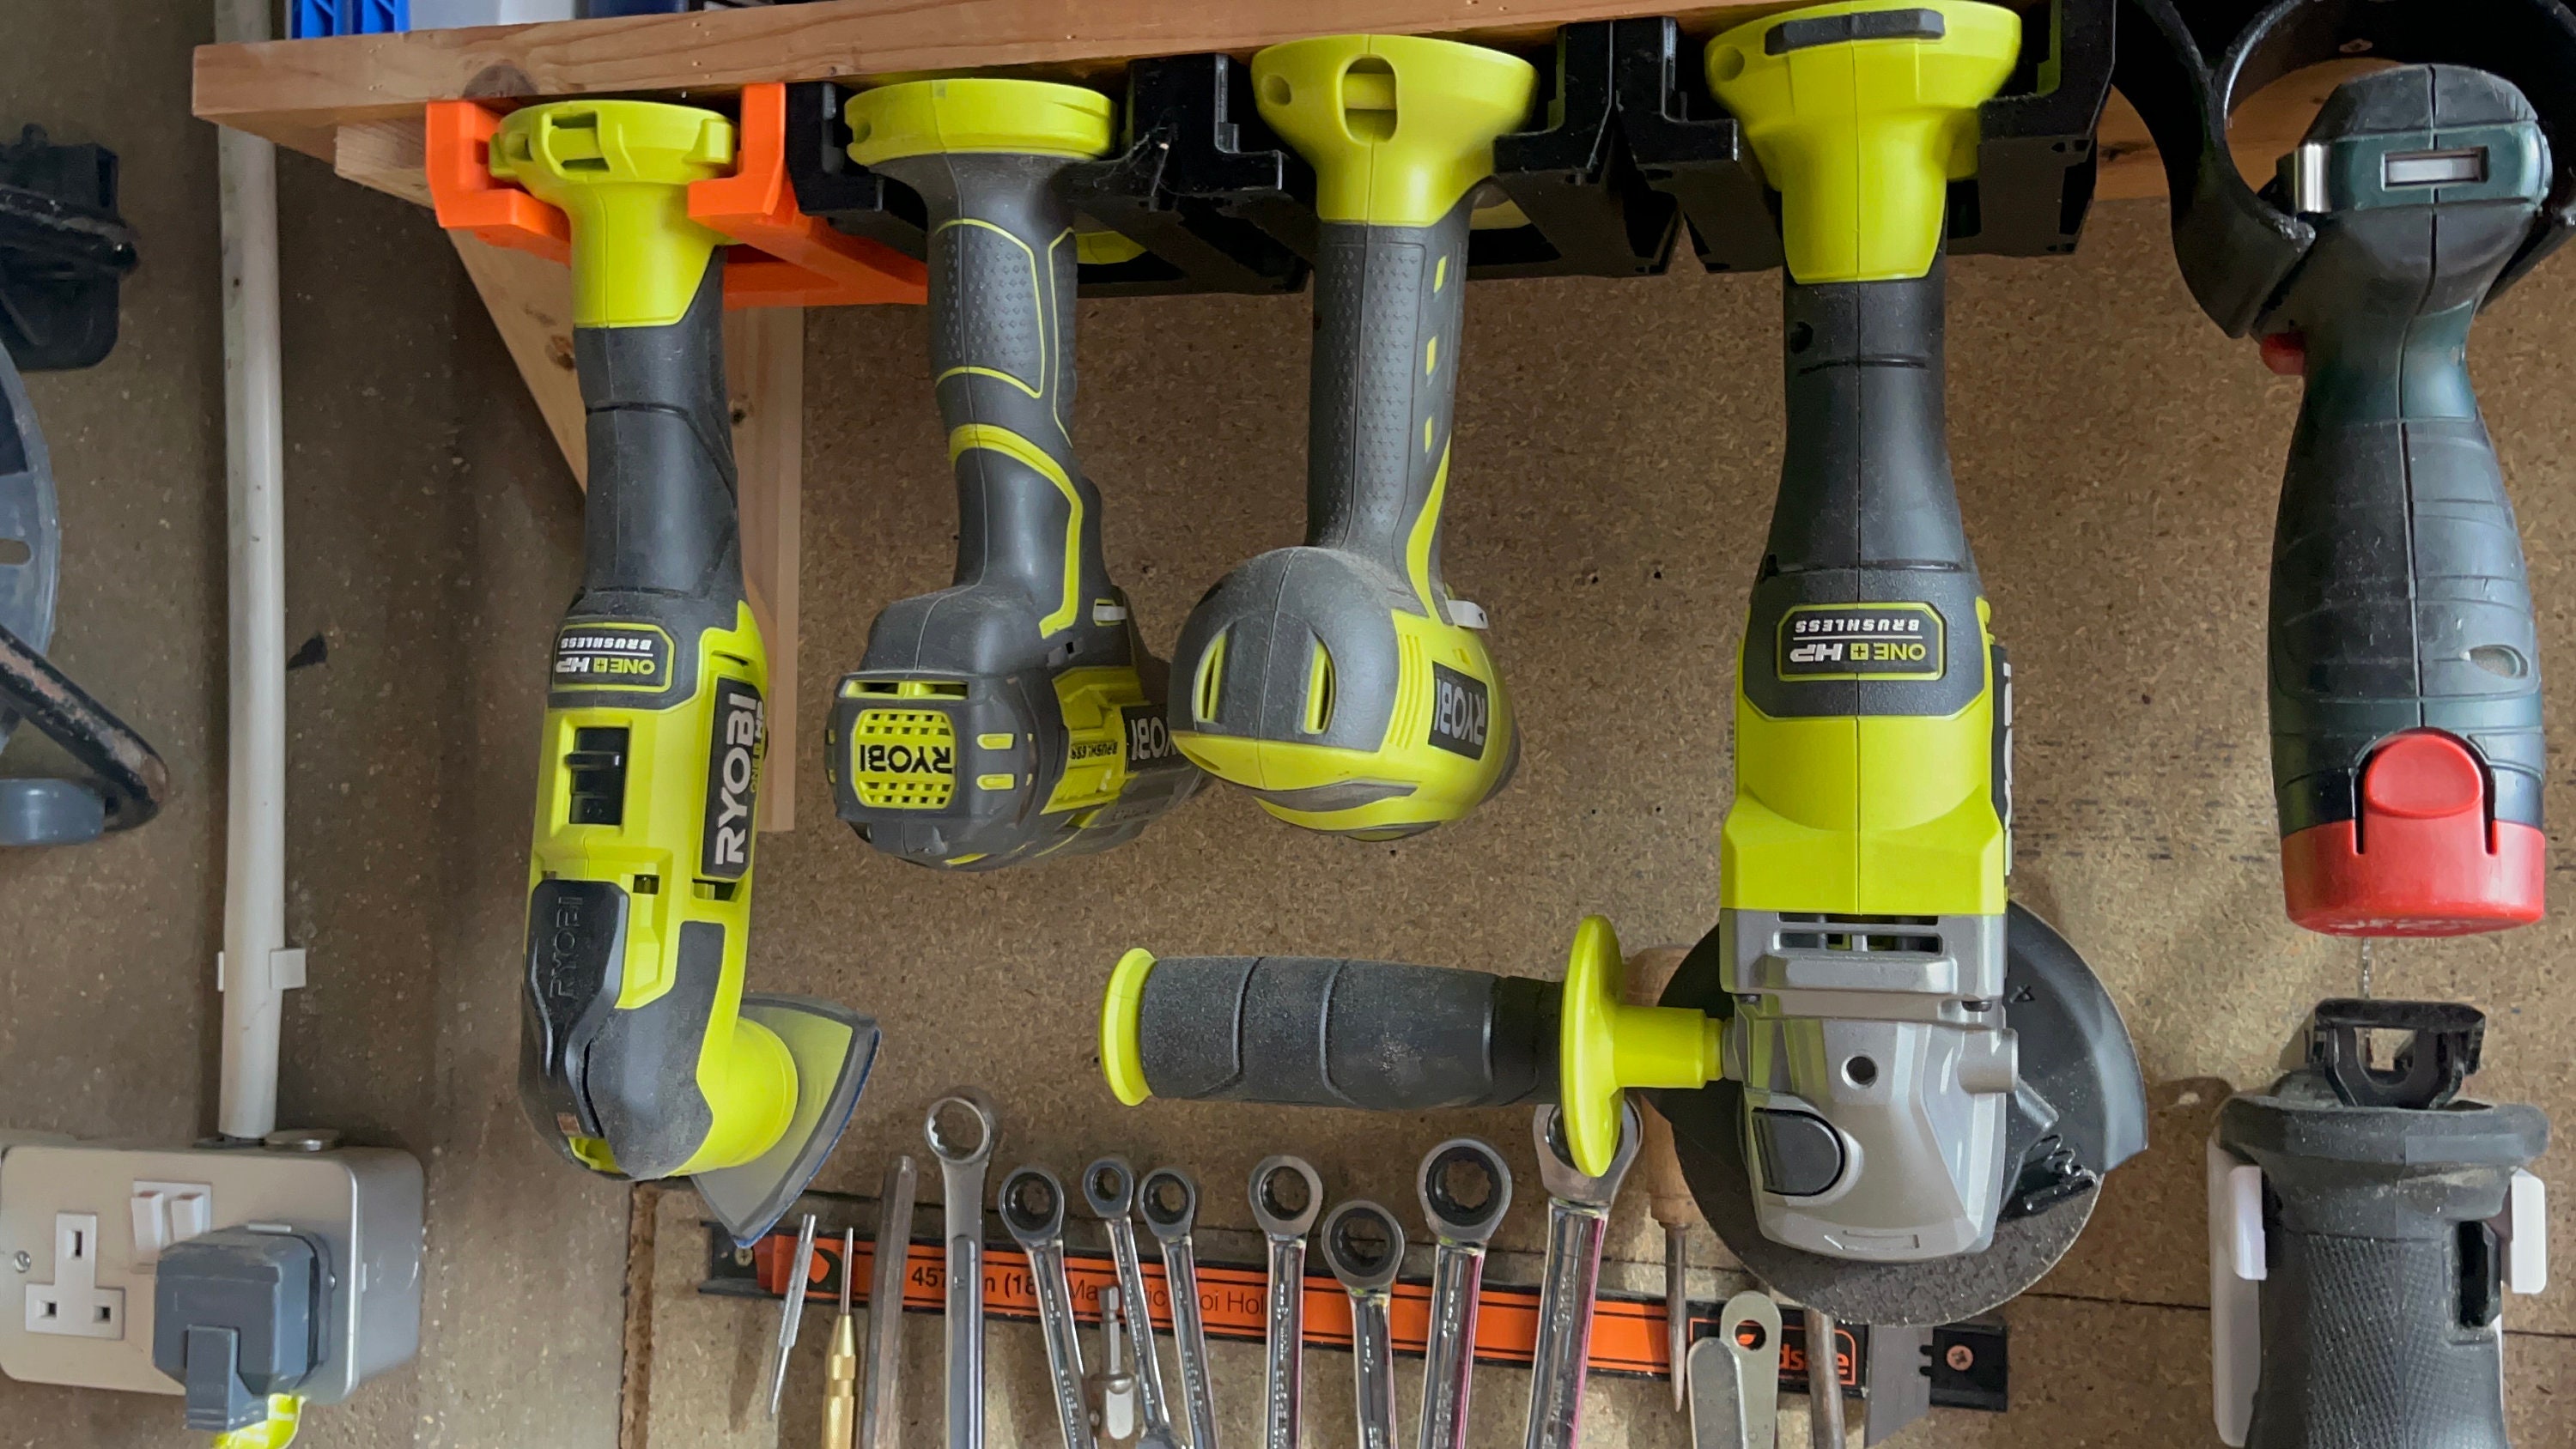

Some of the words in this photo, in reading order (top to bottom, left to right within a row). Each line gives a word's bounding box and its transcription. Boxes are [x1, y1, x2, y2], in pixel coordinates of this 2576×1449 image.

[1794, 618, 1920, 634] BRUSHLESS
[559, 636, 653, 651] BRUSHLESS
[1789, 643, 1844, 664] HP
[555, 657, 590, 675] HP
[1433, 678, 1485, 745] RYOBI
[1130, 717, 1176, 761] YOBI
[860, 744, 953, 774] RYOBI
[714, 692, 756, 865] RYOBI
[549, 896, 584, 1000] RYOBI
[1227, 1290, 1265, 1316] Hol
